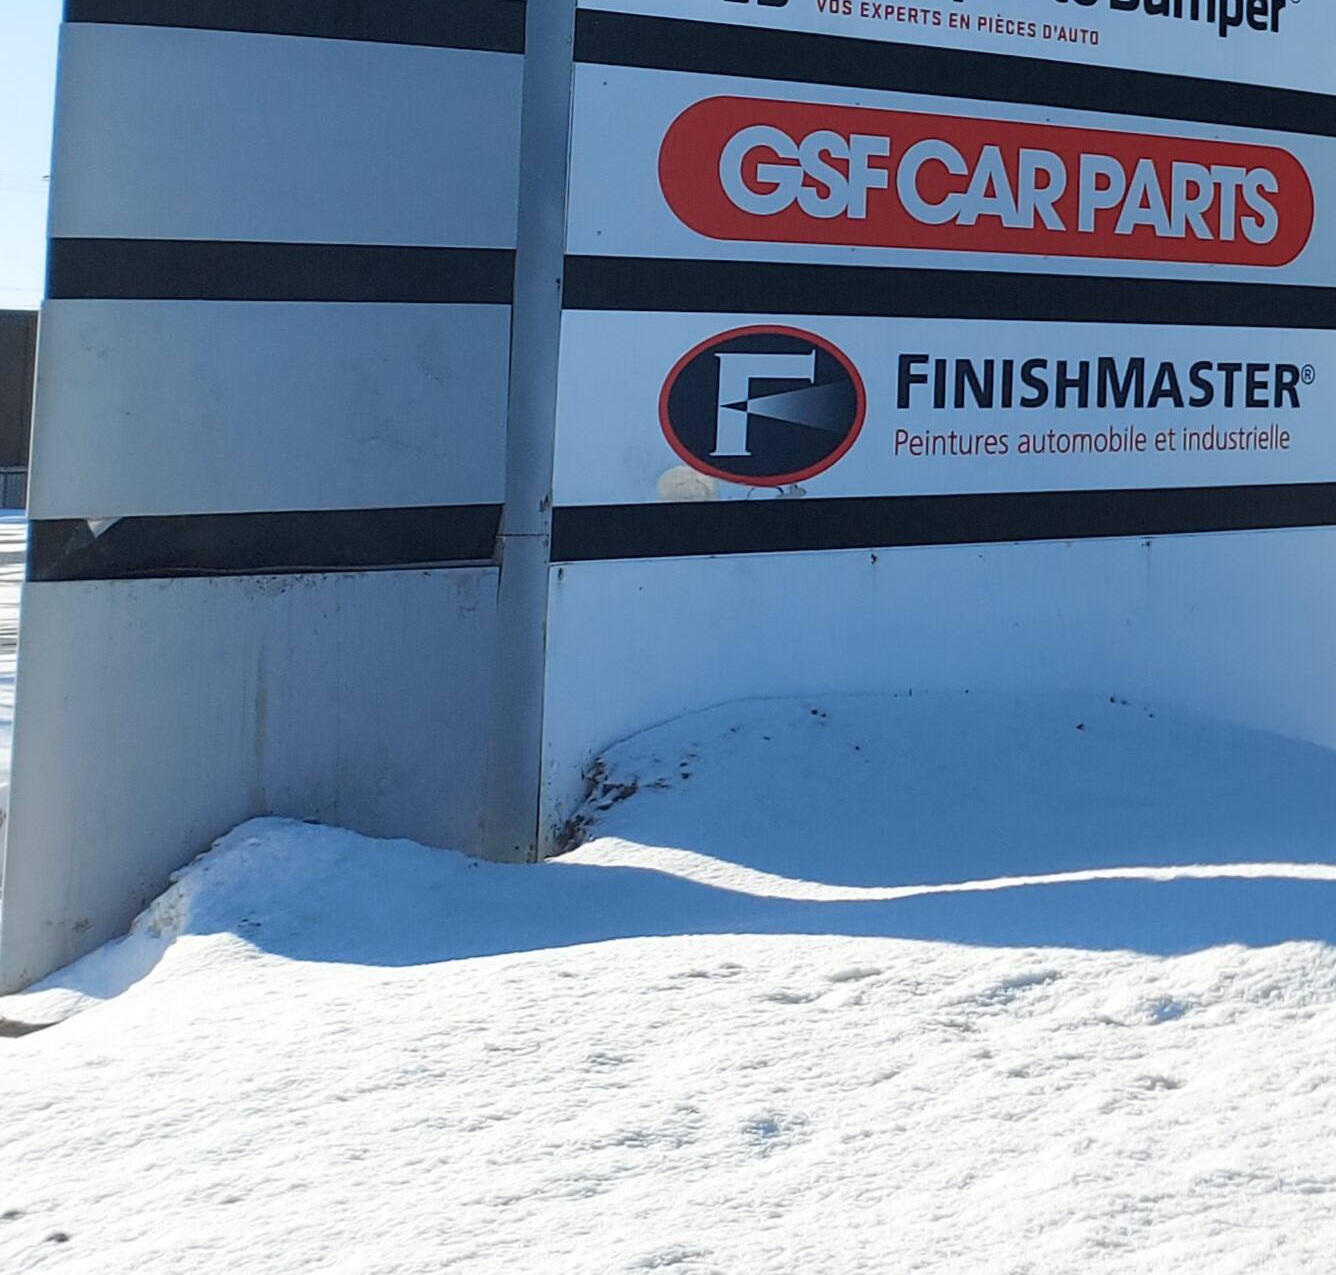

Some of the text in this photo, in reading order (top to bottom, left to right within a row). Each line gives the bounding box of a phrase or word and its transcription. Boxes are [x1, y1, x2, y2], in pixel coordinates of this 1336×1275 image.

[859, 1, 943, 27] EXPERTS
[947, 12, 971, 30] EN
[976, 12, 1038, 38] PIÈCES
[1042, 24, 1100, 46] D'AUTO
[719, 125, 1279, 244] GSF CAR PARTS
[894, 425, 1291, 457] Peintures automobile et industrielle
